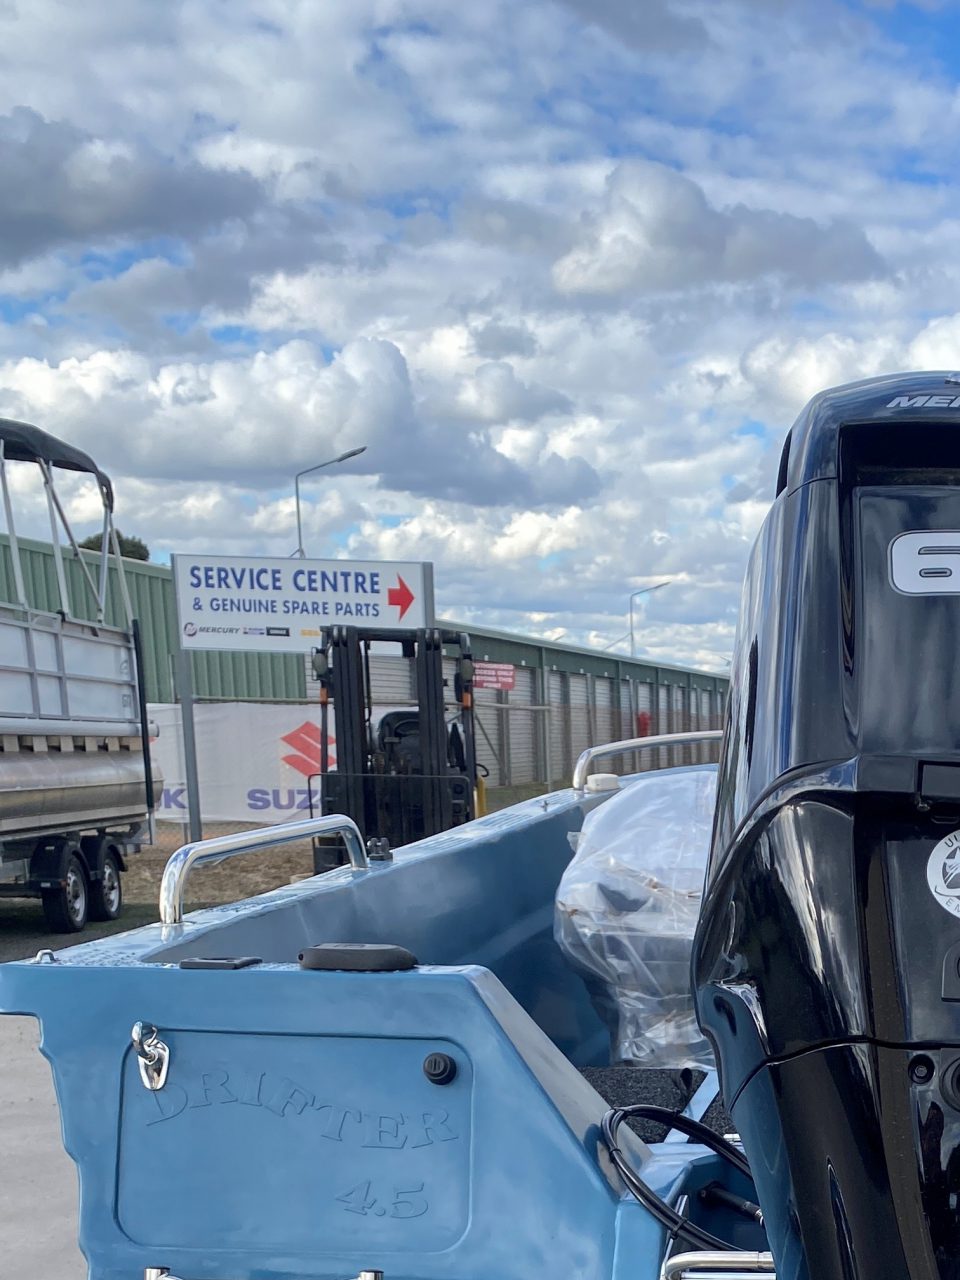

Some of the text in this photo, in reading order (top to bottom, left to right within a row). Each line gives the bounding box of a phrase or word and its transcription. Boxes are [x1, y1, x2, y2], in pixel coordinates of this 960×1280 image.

[190, 565, 381, 594] SERVICE CENTRE
[192, 597, 380, 617] & GENUINE SPARE PARTS
[198, 626, 240, 634] MERCURY
[146, 1070, 459, 1150] DRIFTER
[335, 1180, 429, 1219] 4.5
